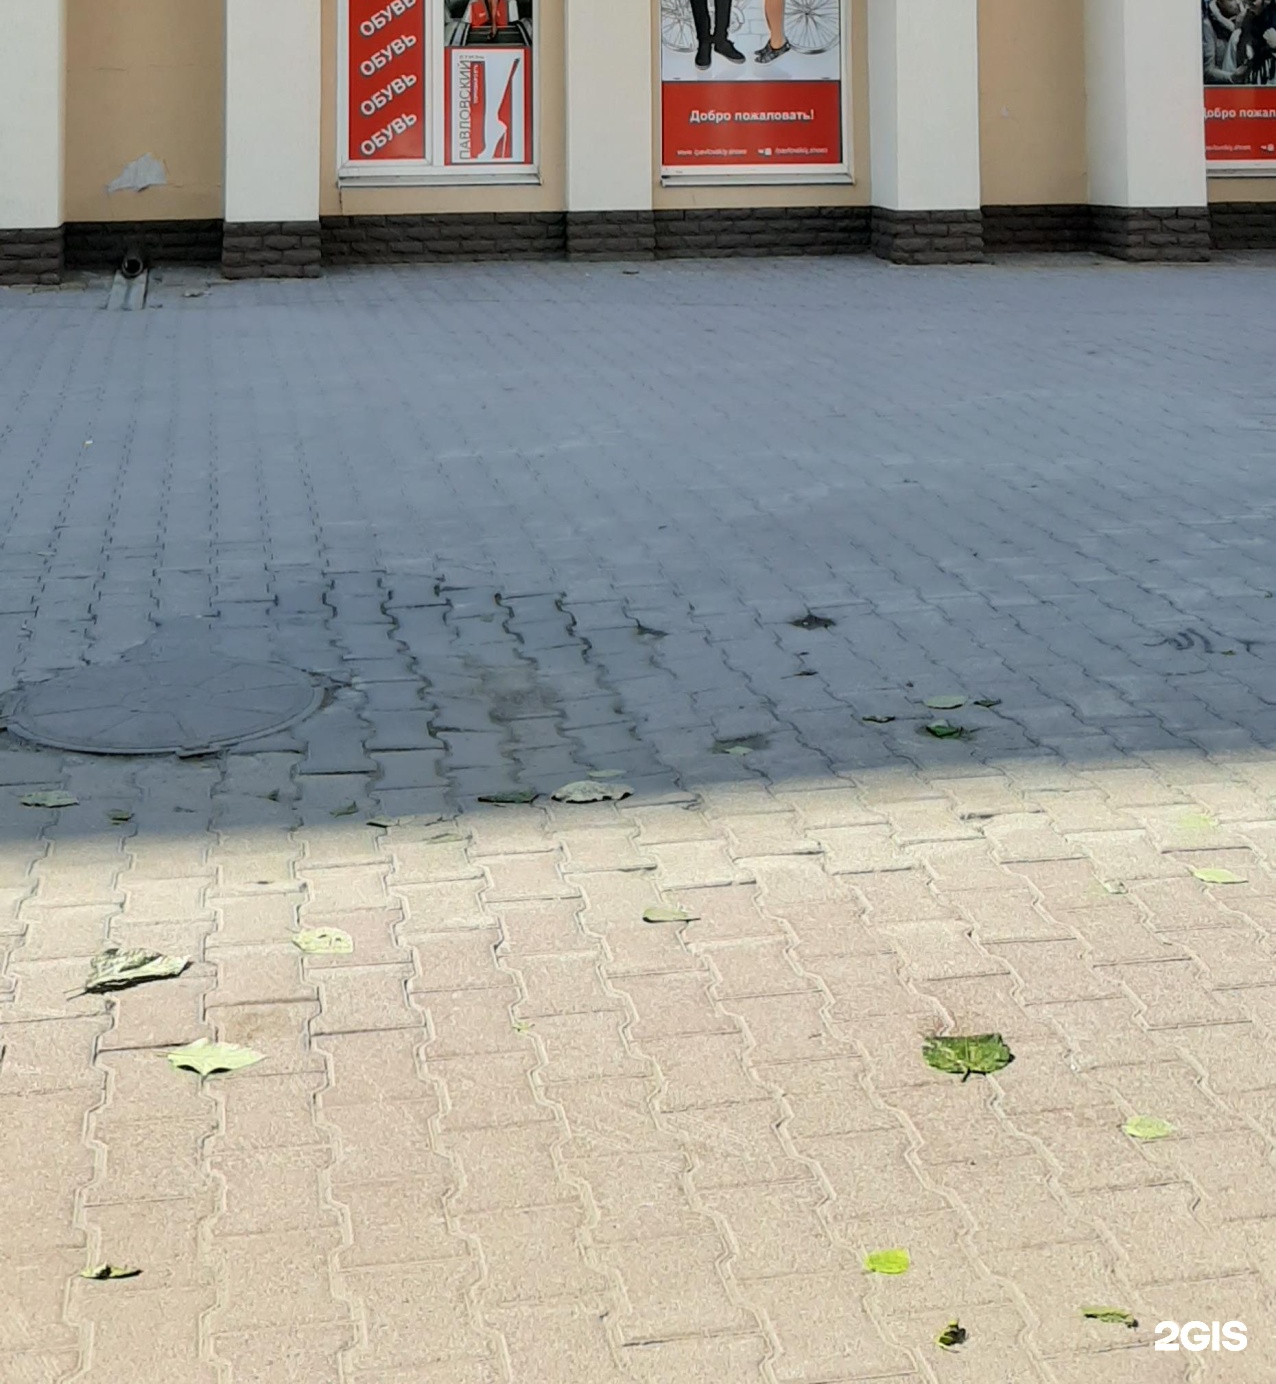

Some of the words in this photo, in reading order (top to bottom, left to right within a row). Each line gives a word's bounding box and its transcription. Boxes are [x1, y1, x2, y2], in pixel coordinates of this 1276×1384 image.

[359, 34, 417, 77] ОБУВЬ
[360, 73, 417, 116] ОБУВЬ
[458, 60, 471, 160] ПАВЛОВСКИЙ
[1204, 107, 1237, 119] обро
[360, 113, 417, 156] ОБУВЬ
[689, 110, 732, 124] Добро
[734, 109, 815, 122] пожаловать!
